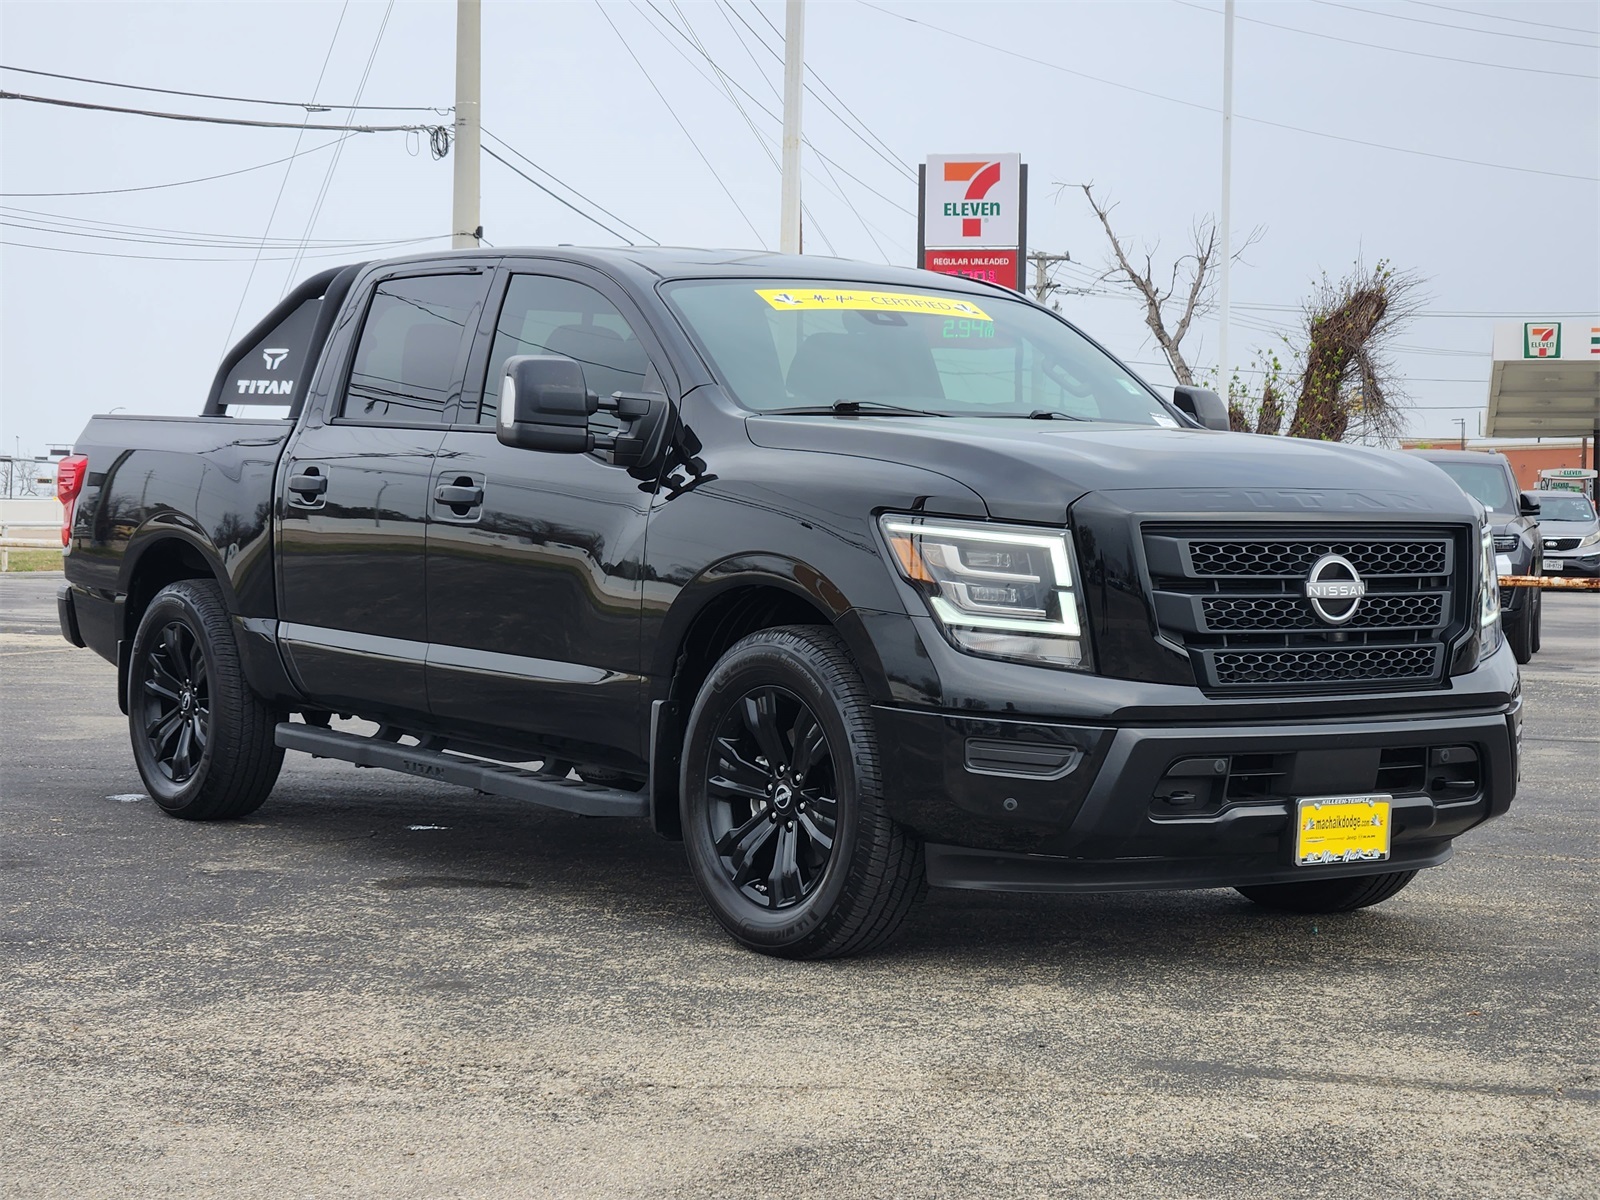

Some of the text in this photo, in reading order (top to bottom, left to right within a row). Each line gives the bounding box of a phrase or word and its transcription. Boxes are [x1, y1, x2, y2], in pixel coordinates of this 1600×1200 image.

[944, 162, 1001, 200] 7
[933, 257, 1009, 266] REGULAR UNLEADED
[871, 296, 952, 311] CERTIFIED
[1532, 328, 1554, 341] 7
[237, 379, 294, 395] TITAN
[1308, 585, 1365, 596] NISSAN
[403, 760, 445, 776] TITAN
[1316, 814, 1370, 830] machaikdodge.com
[1320, 848, 1366, 863] Mac Haik
